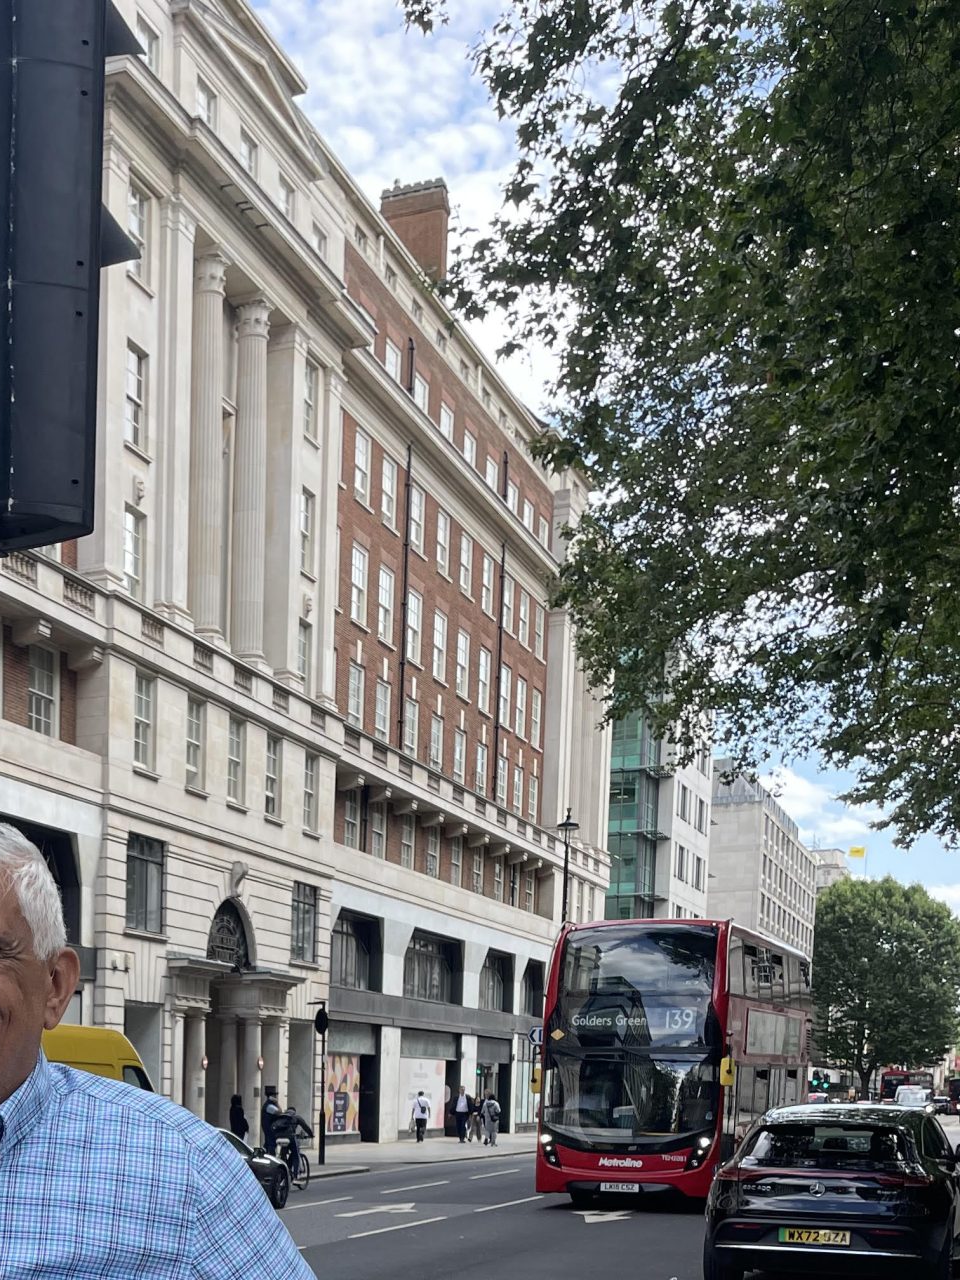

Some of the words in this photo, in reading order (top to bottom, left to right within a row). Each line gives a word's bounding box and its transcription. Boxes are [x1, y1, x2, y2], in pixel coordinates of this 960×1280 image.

[571, 1014, 612, 1026] Golders
[615, 1014, 647, 1026] Green
[665, 1009, 694, 1029] 139
[598, 1156, 643, 1168] Metroline
[788, 1229, 820, 1242] WX72
